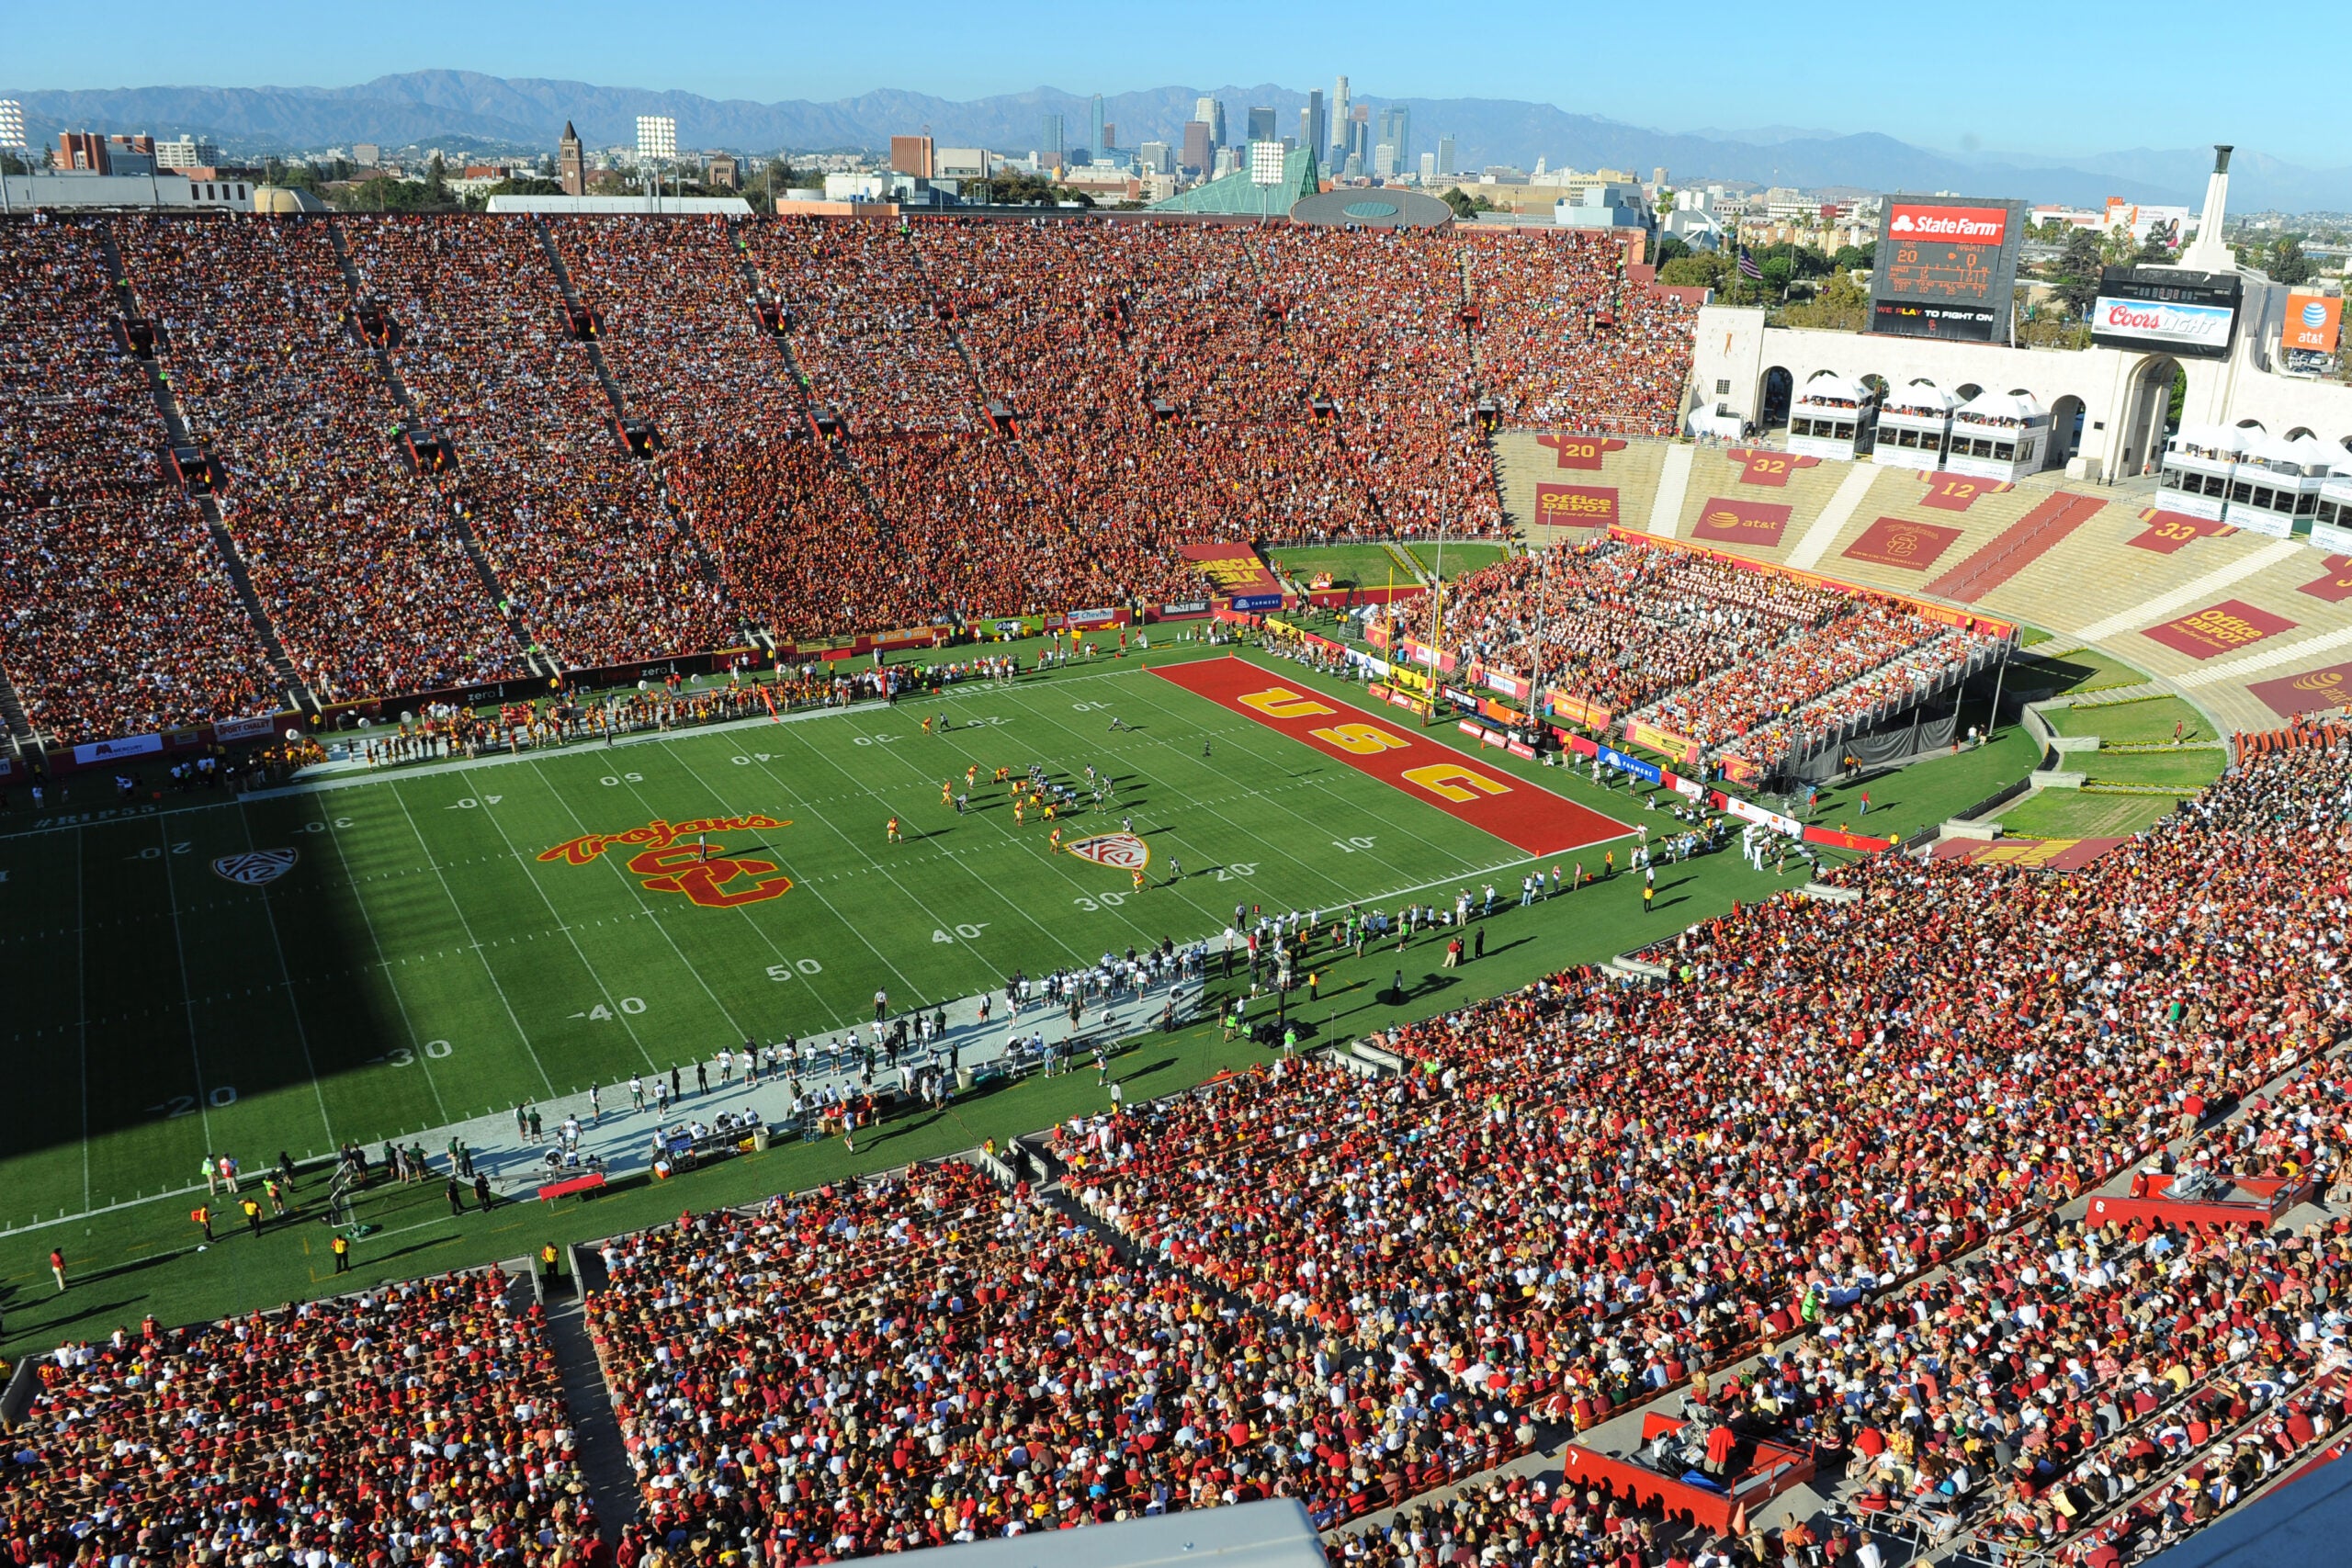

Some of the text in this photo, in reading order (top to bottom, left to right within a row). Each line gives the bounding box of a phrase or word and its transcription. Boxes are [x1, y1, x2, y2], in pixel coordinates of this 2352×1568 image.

[1897, 249, 1918, 264] 20
[1967, 254, 1977, 266] 0
[1895, 308, 1923, 316] PLAY
[1924, 310, 1940, 318] TO
[1941, 310, 1974, 321] FIGHT
[1975, 313, 1994, 321] ON
[2109, 305, 2160, 330] Coors
[2159, 316, 2217, 335] LIGHT
[2298, 331, 2324, 345] at&t
[1565, 444, 1595, 457] 20
[1752, 458, 1785, 474] 32
[1940, 481, 1975, 499] 12
[1541, 493, 1611, 505] Office
[1542, 502, 1611, 513] DEPOT
[1742, 519, 1778, 530] at&t
[2154, 522, 2196, 540] 33
[1081, 608, 1113, 619] Chevron
[1164, 602, 1206, 614] MUSCLE MILK
[2181, 616, 2247, 644] DEPOT
[2199, 610, 2263, 638] Office
[641, 666, 668, 677] zero
[468, 690, 496, 702] zero
[1071, 701, 1108, 712] 10
[243, 721, 270, 731] CHALET
[967, 716, 1006, 728] 20
[853, 734, 894, 746] 30
[730, 752, 771, 765] 40
[1623, 761, 1653, 777] FARMERS
[599, 772, 645, 786] 50
[457, 794, 503, 809] 40
[305, 817, 356, 833] 30
[536, 815, 794, 865] Trojans
[1331, 836, 1374, 853] 10
[140, 841, 192, 860] 20
[626, 843, 794, 908] SC
[1211, 863, 1257, 883] 20
[1073, 892, 1127, 912] 30
[932, 923, 983, 944] 40
[764, 958, 823, 982] 50
[588, 997, 648, 1021] 40
[389, 1040, 453, 1068] 30
[167, 1086, 238, 1118] 20
[2095, 1201, 2105, 1213] 6
[1570, 1450, 1578, 1465] 7
